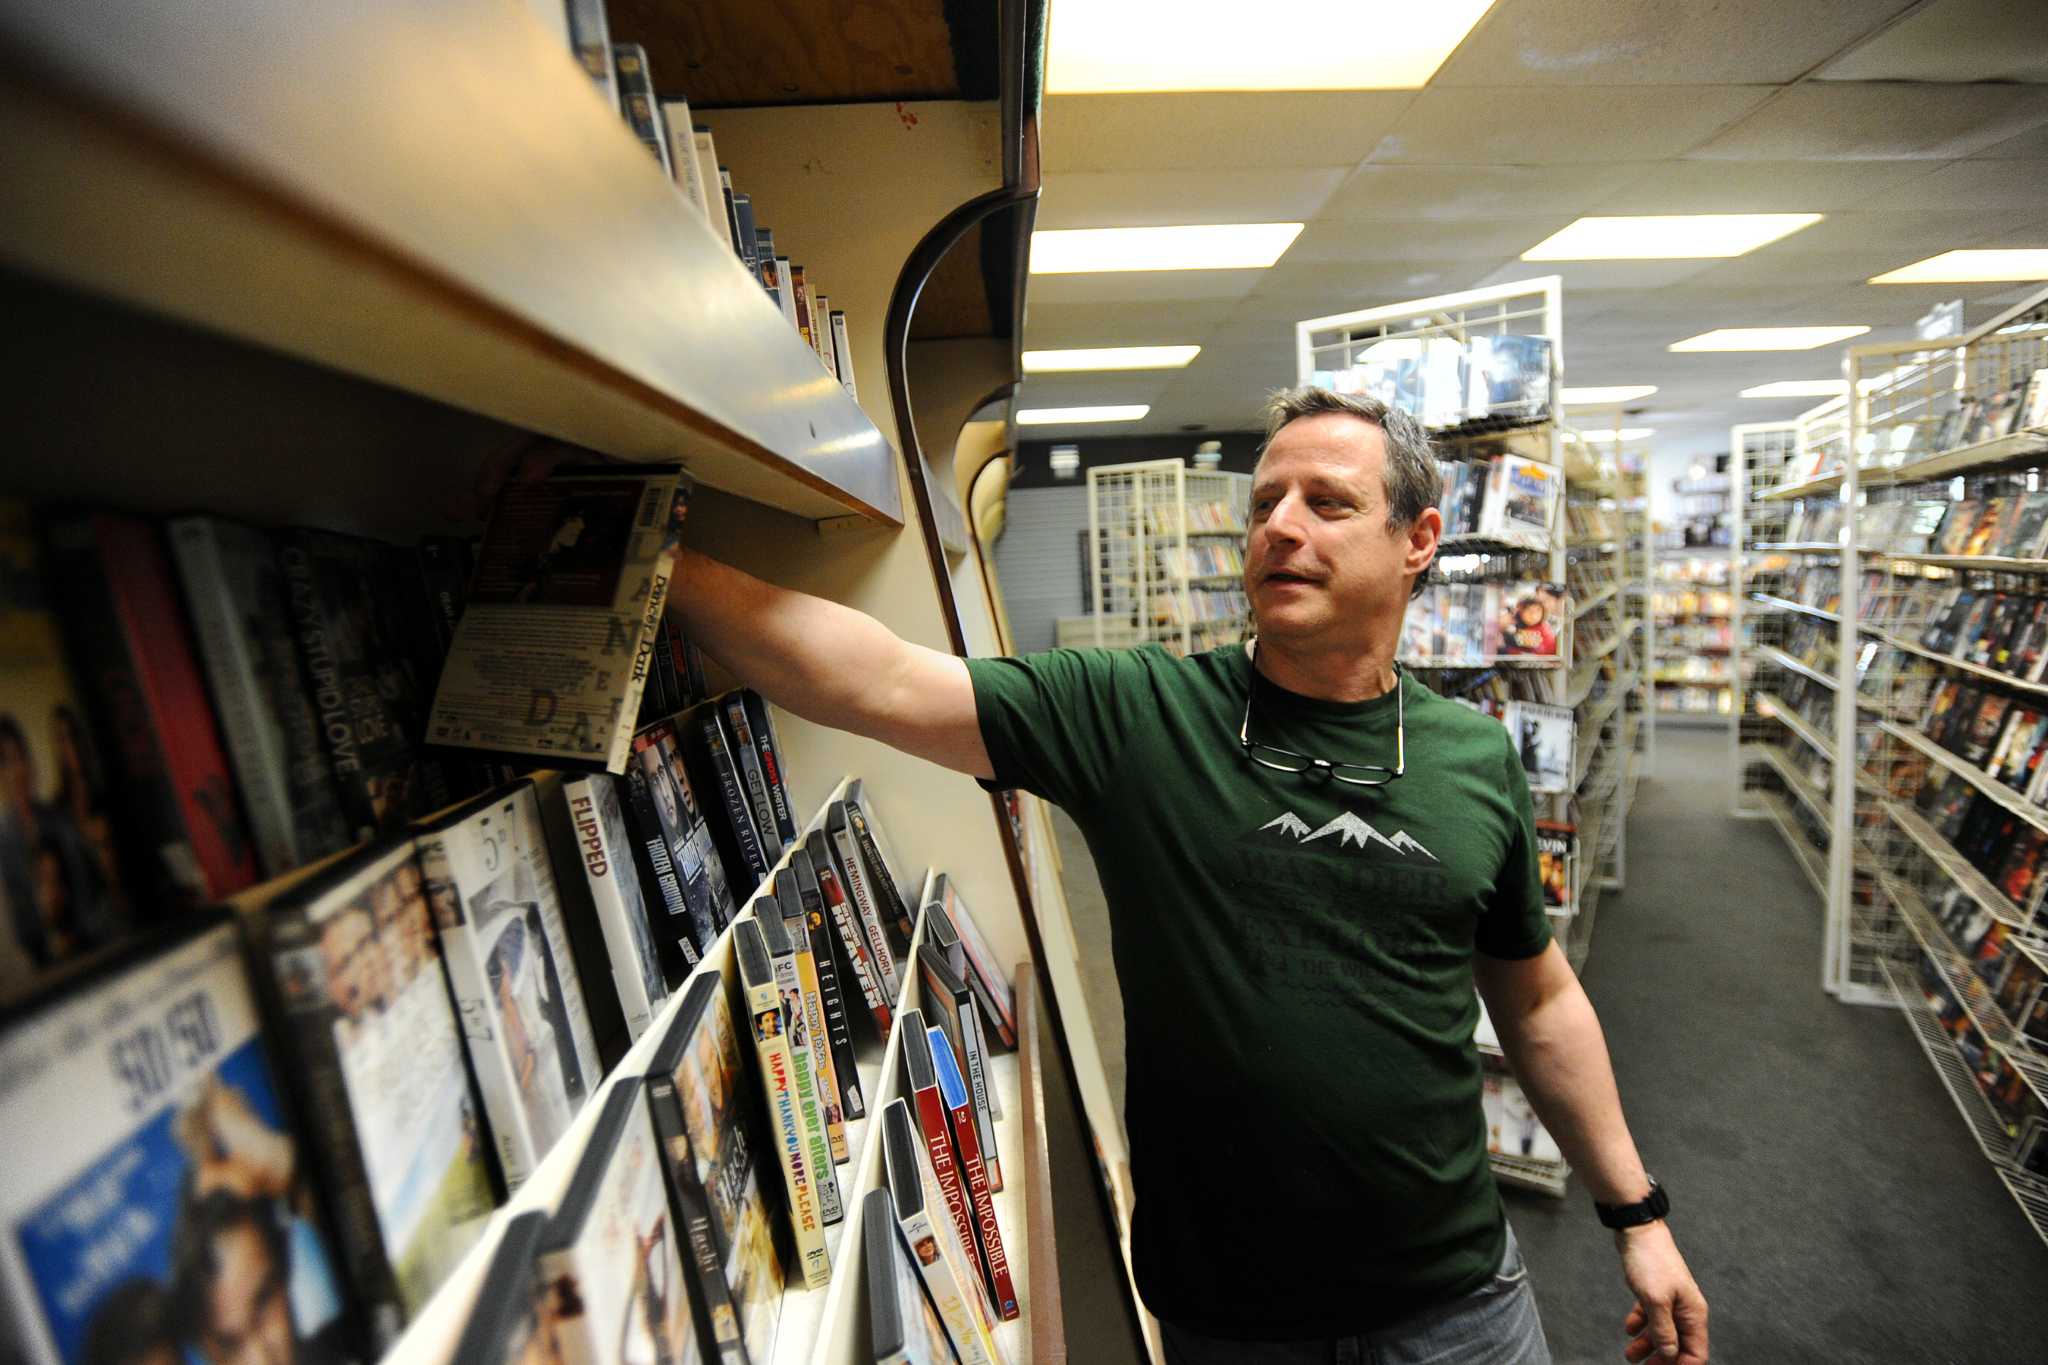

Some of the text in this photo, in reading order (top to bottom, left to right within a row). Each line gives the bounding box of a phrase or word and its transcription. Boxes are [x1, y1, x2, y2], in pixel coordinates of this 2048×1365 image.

[631, 637, 655, 684] Dark
[747, 767, 777, 837] GET LOW
[759, 733, 788, 822] THE GHOST WRITER
[480, 816, 499, 872] 5
[571, 795, 608, 879] FLIPPED
[720, 769, 761, 870] FROZEN RIVER
[1535, 836, 1568, 854] EVIN
[645, 836, 687, 916] FROZEN GROUND
[844, 856, 874, 918] HEMINGWAY
[868, 924, 894, 978] GELLHORN
[831, 904, 880, 1010] HEAVEN
[818, 958, 848, 1047] HEIGHTS
[792, 1051, 814, 1099] happy
[969, 1050, 987, 1112] IN THE HOUSE
[801, 1098, 821, 1134] ever
[809, 1131, 830, 1182] afters
[930, 1134, 951, 1171] THE
[966, 1153, 1009, 1279] THE IMPOSSIBLE
